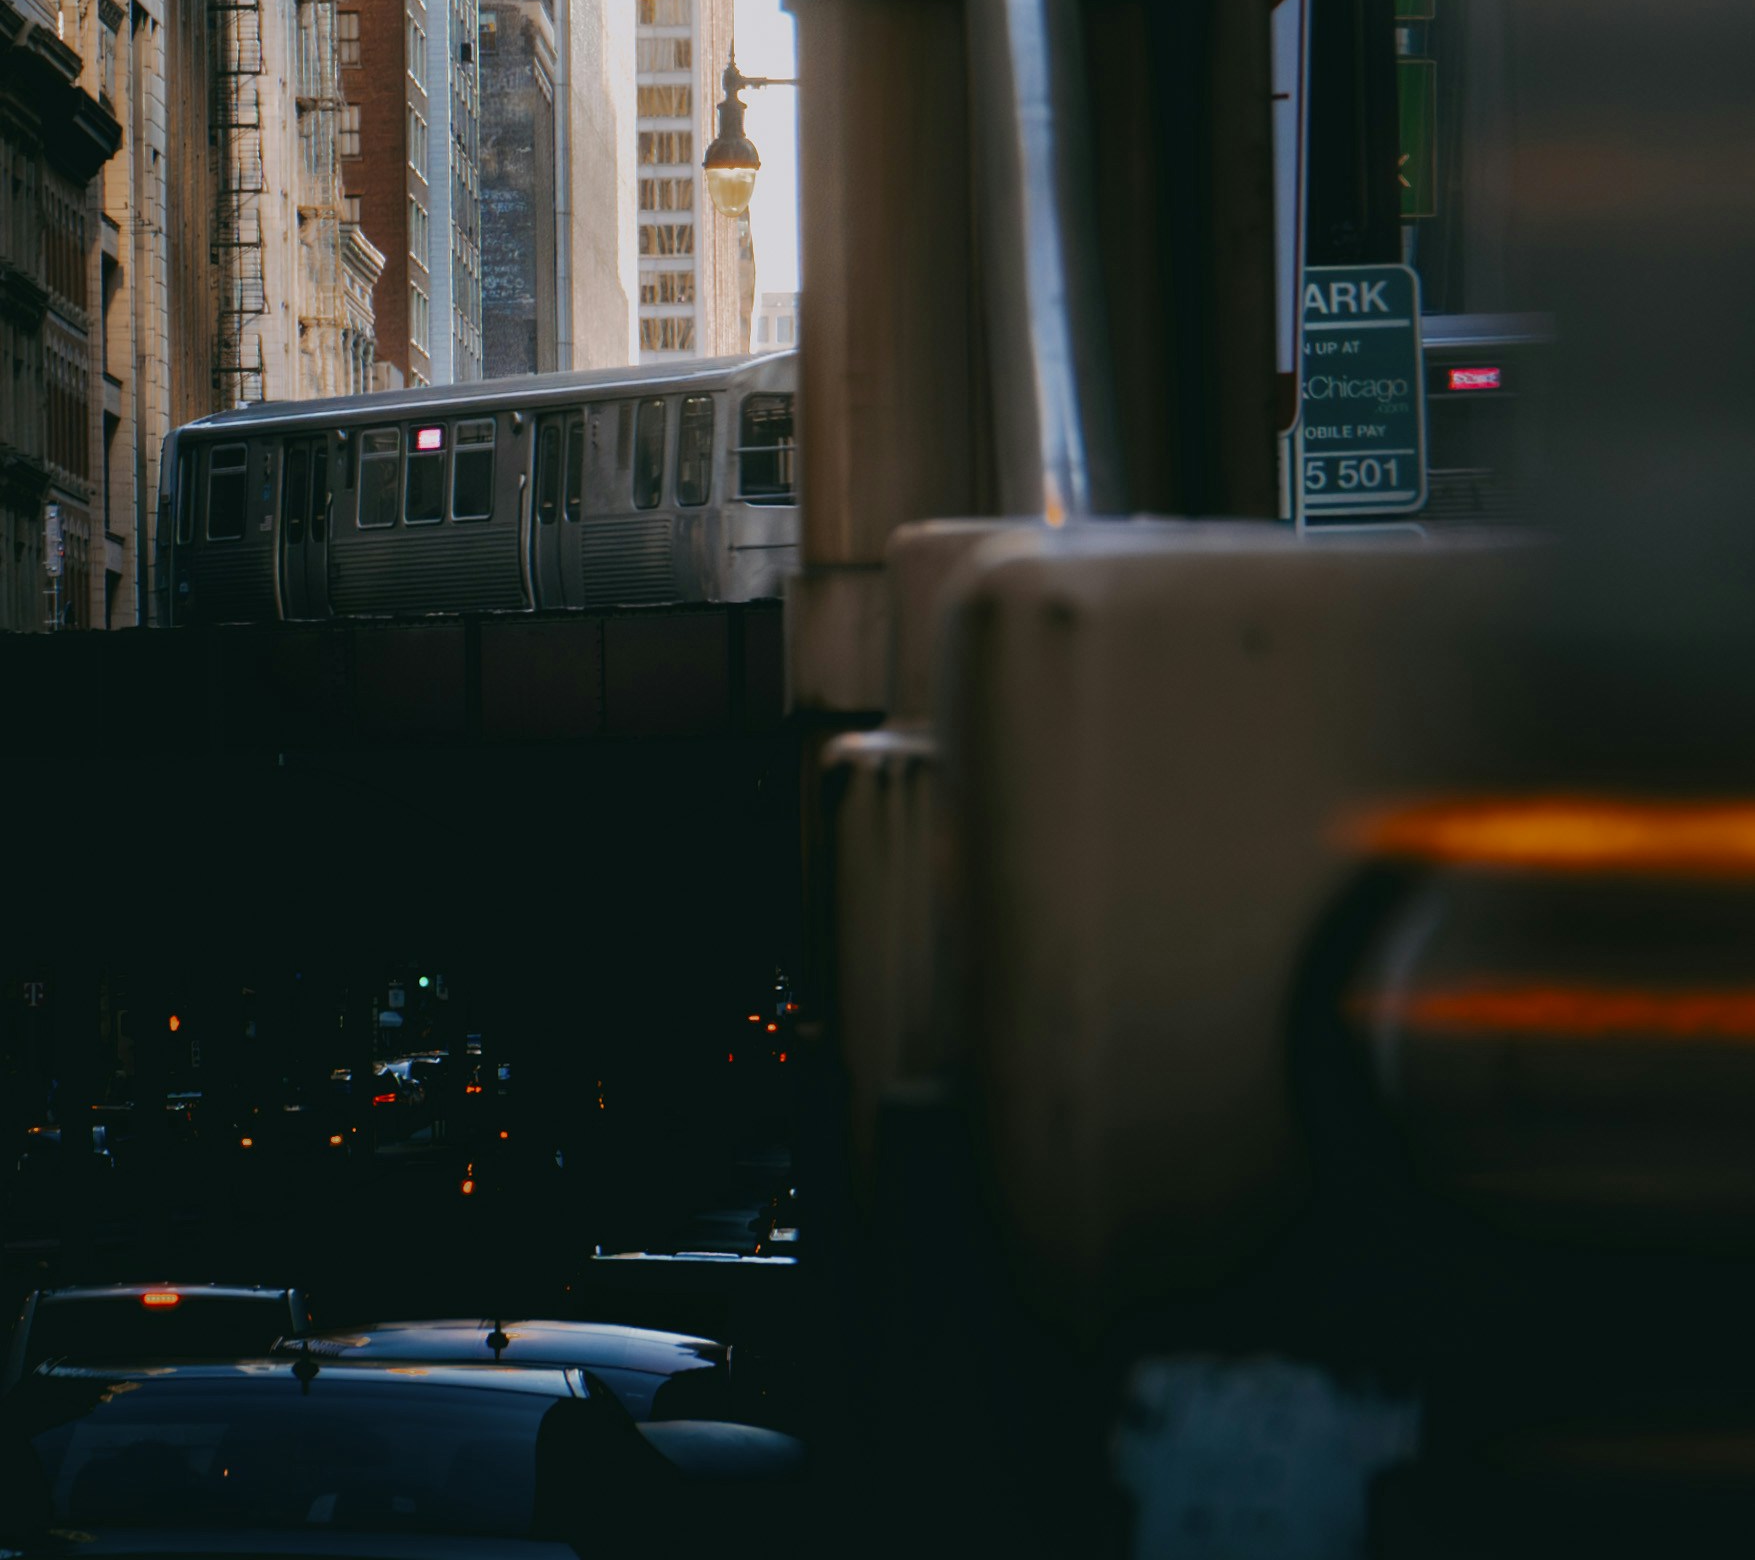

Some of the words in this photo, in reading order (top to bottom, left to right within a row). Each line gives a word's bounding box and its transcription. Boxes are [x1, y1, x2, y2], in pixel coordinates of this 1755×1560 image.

[1303, 280, 1391, 315] ARK
[1315, 342, 1338, 355] UP
[1341, 339, 1361, 354] AT
[1356, 424, 1387, 438] PAY
[1305, 461, 1327, 491] 5
[1337, 458, 1398, 490] 501
